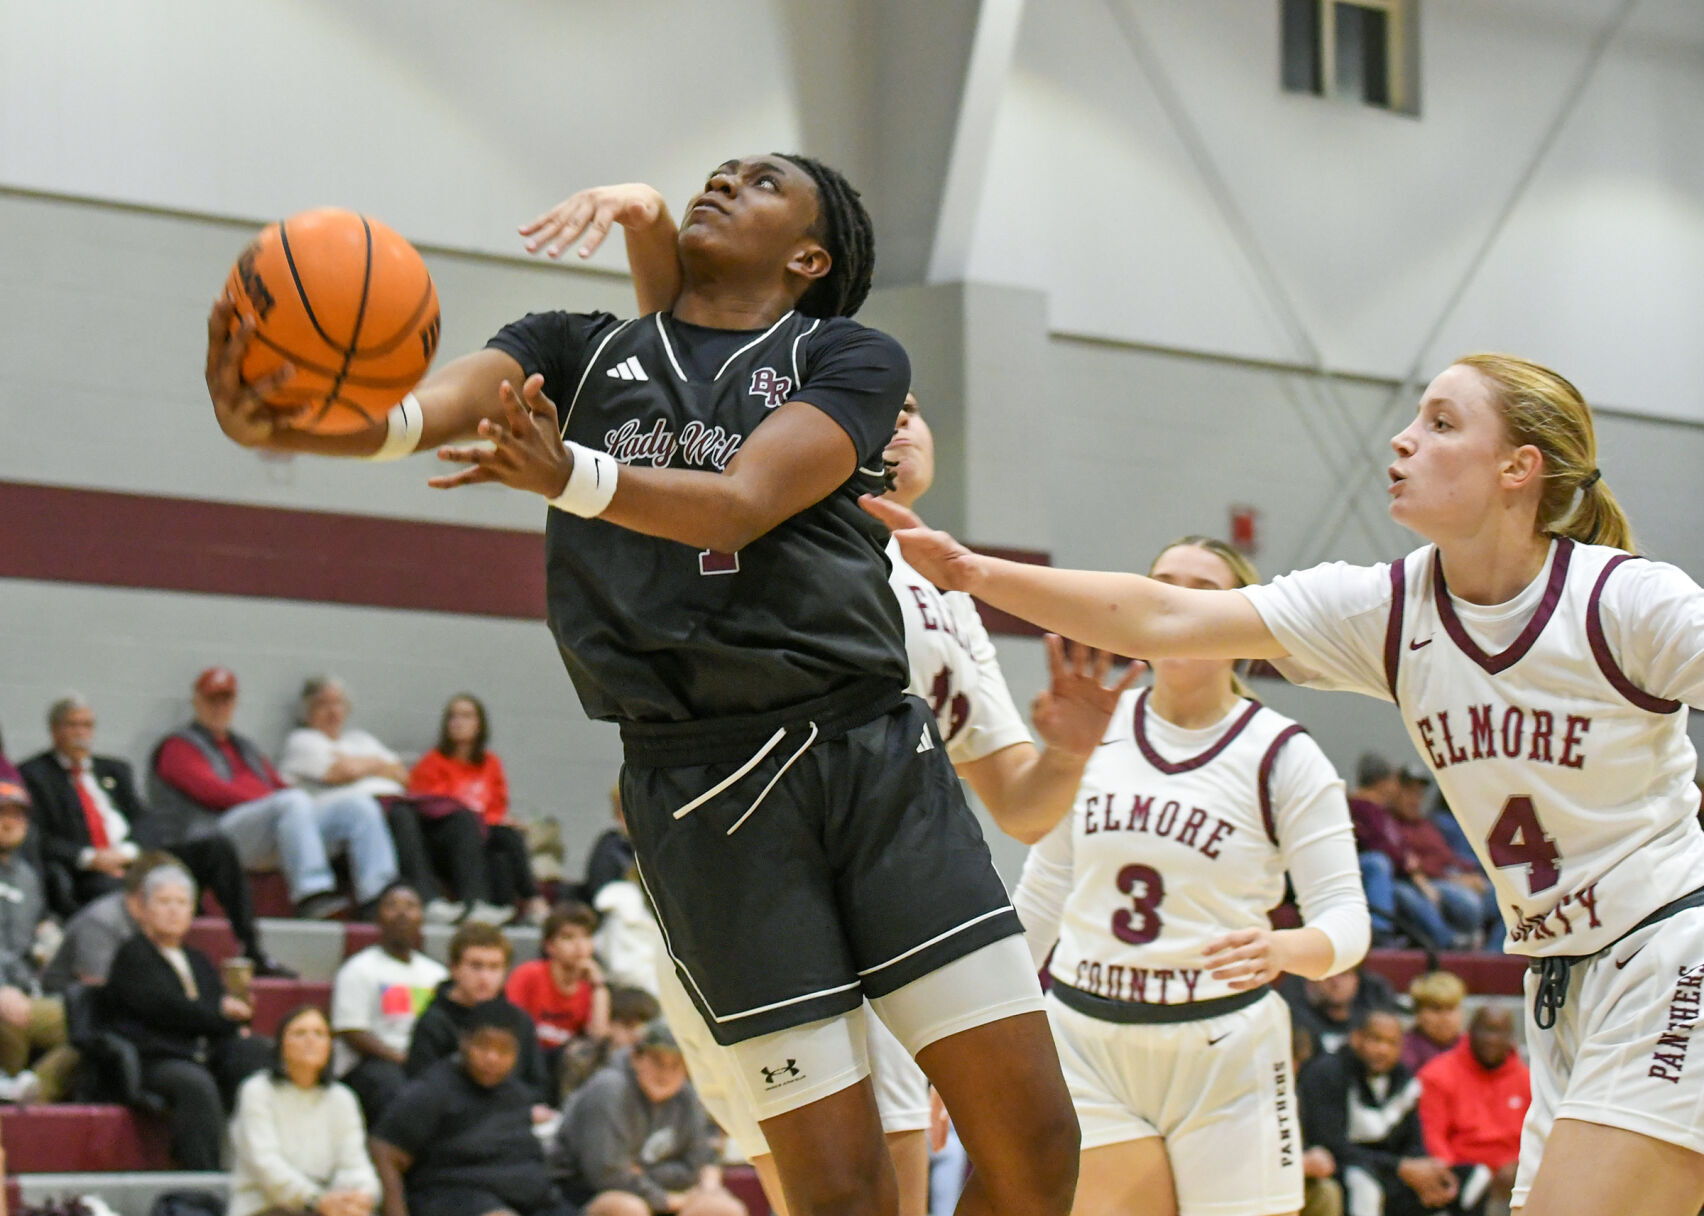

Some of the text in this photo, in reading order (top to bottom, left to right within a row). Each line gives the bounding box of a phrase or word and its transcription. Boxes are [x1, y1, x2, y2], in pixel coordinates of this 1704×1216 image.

[749, 366, 793, 408] BR
[604, 418, 679, 468] Lady
[1416, 704, 1592, 770] ELMORE
[1085, 793, 1236, 860] ELMORE
[1485, 794, 1563, 897] 4
[1112, 863, 1166, 946] 3
[1074, 960, 1203, 1005] COUNTY
[1273, 1061, 1293, 1168] PANTHERS
